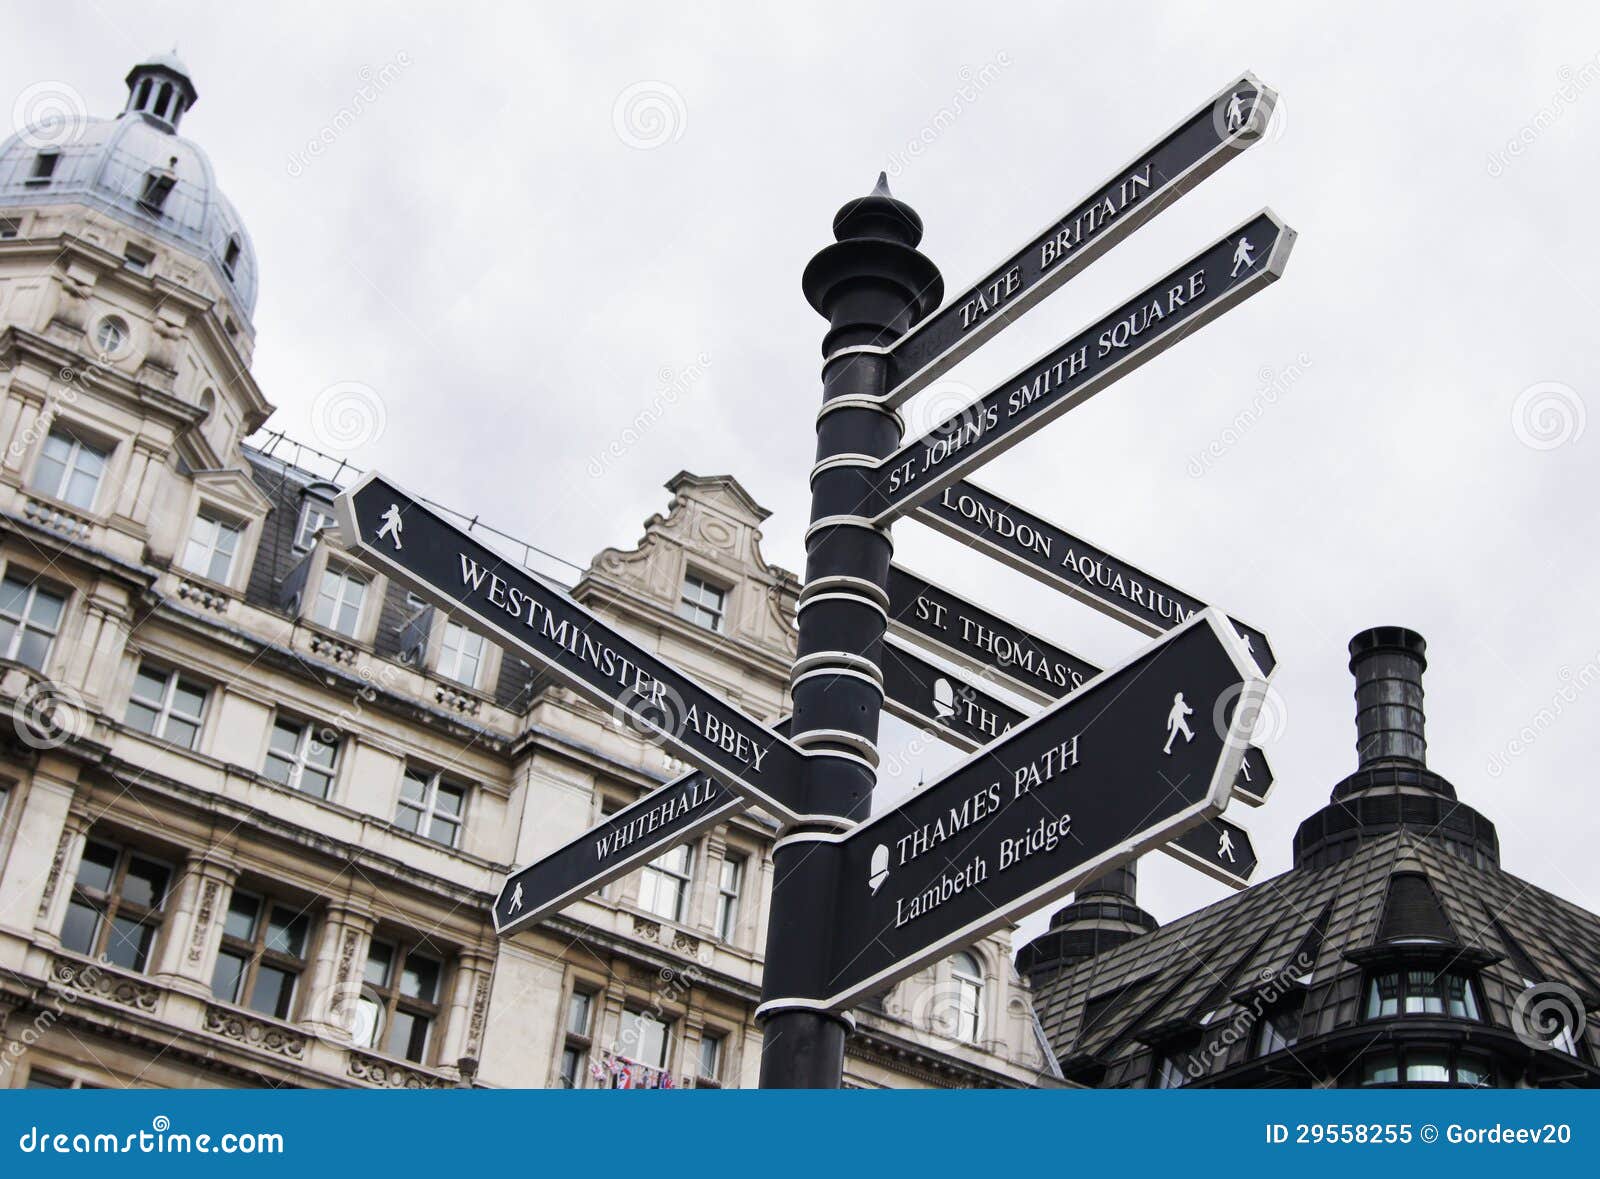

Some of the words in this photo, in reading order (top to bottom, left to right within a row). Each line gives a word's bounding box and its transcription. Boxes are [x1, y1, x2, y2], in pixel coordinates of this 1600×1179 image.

[959, 265, 1021, 329] TATE
[1040, 164, 1151, 269] BRITAIN
[889, 459, 916, 494] ST.
[1008, 345, 1088, 416] SMITH
[1098, 269, 1205, 358] SQUARE
[941, 487, 1052, 558] LONDON
[1061, 549, 1195, 624] AQUARIUM
[459, 553, 667, 712] WESTMINSTER
[683, 704, 768, 772] ABBEY
[916, 596, 948, 630] ST.
[959, 615, 1083, 692] THOMAS'S
[595, 777, 717, 861] WHITEHALL
[896, 782, 1001, 866] THAMES
[1014, 734, 1079, 798] PATH
[894, 856, 987, 929] Lambeth
[1000, 813, 1072, 871] Bridge
